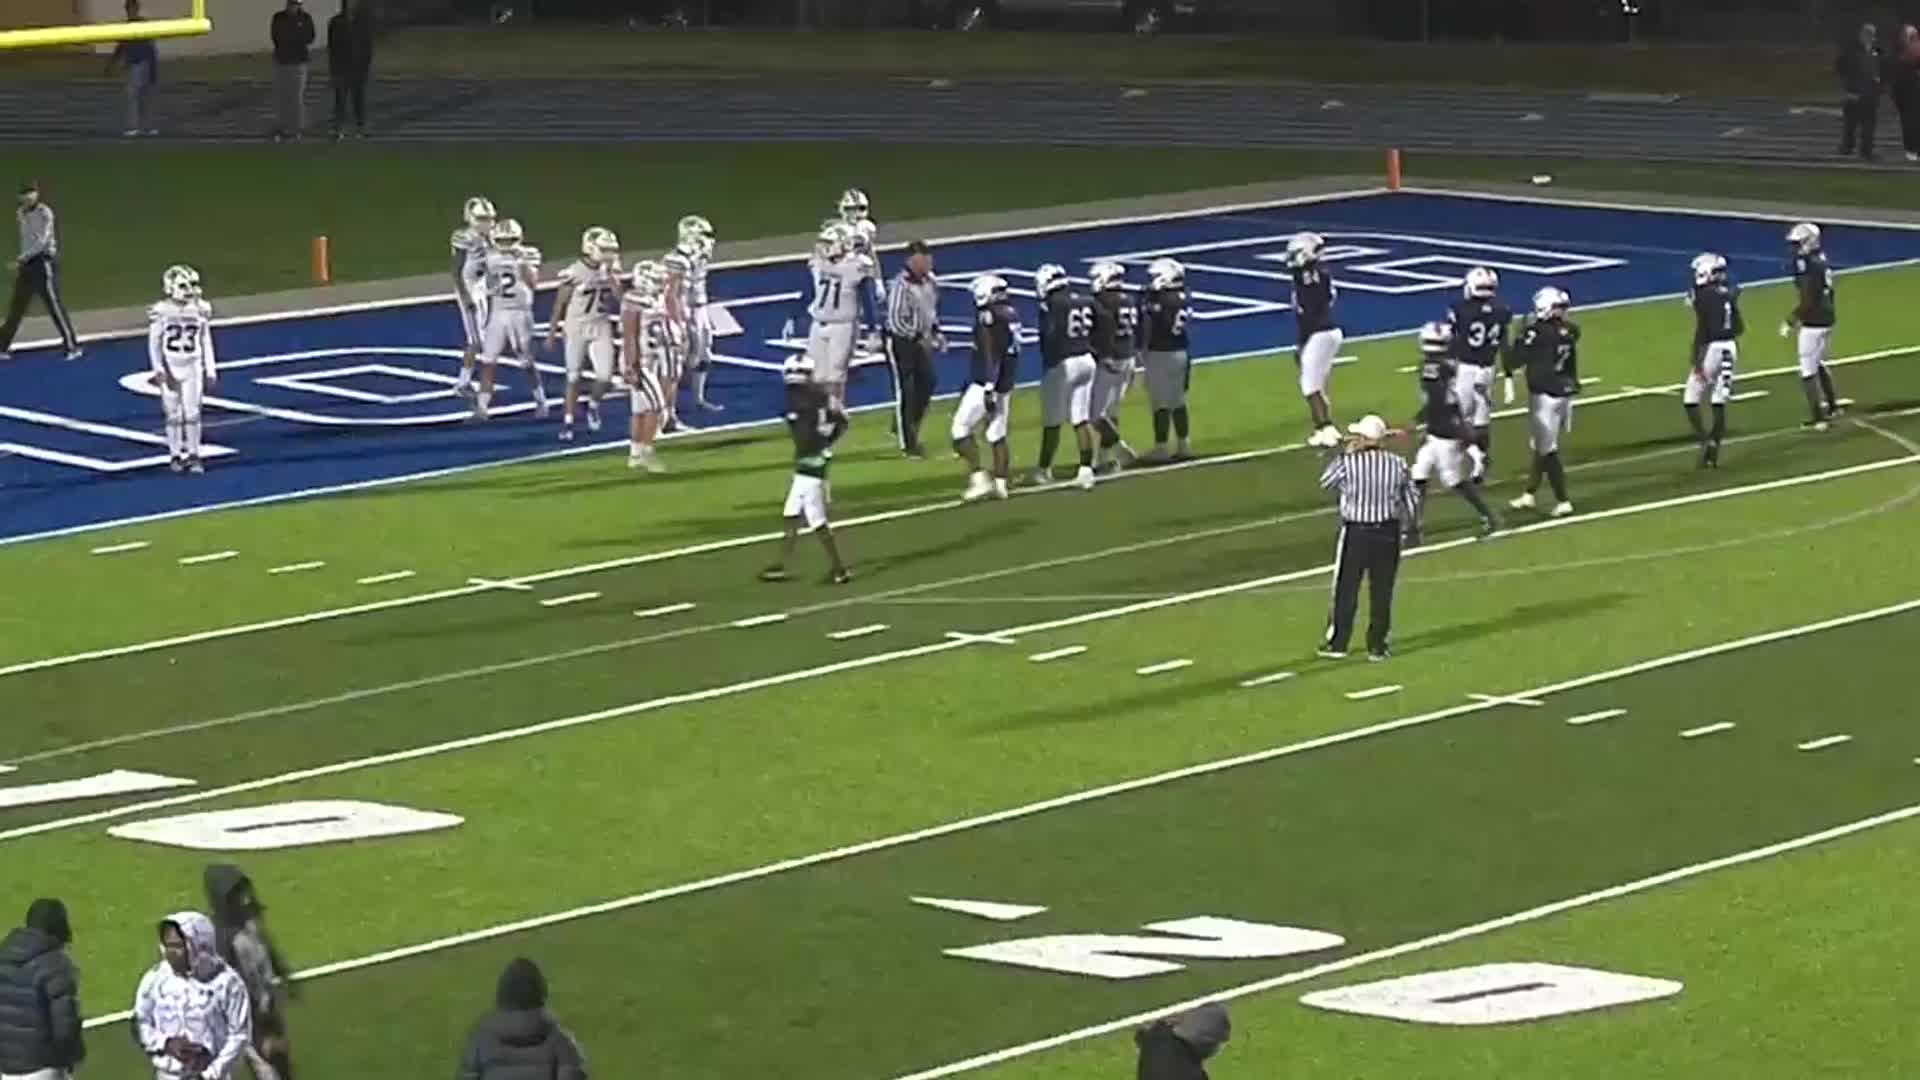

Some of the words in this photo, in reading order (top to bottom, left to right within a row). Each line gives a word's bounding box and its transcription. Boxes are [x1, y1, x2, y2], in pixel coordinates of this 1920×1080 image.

[818, 279, 841, 310] 71
[166, 324, 199, 353] 23
[1468, 321, 1501, 347] 34
